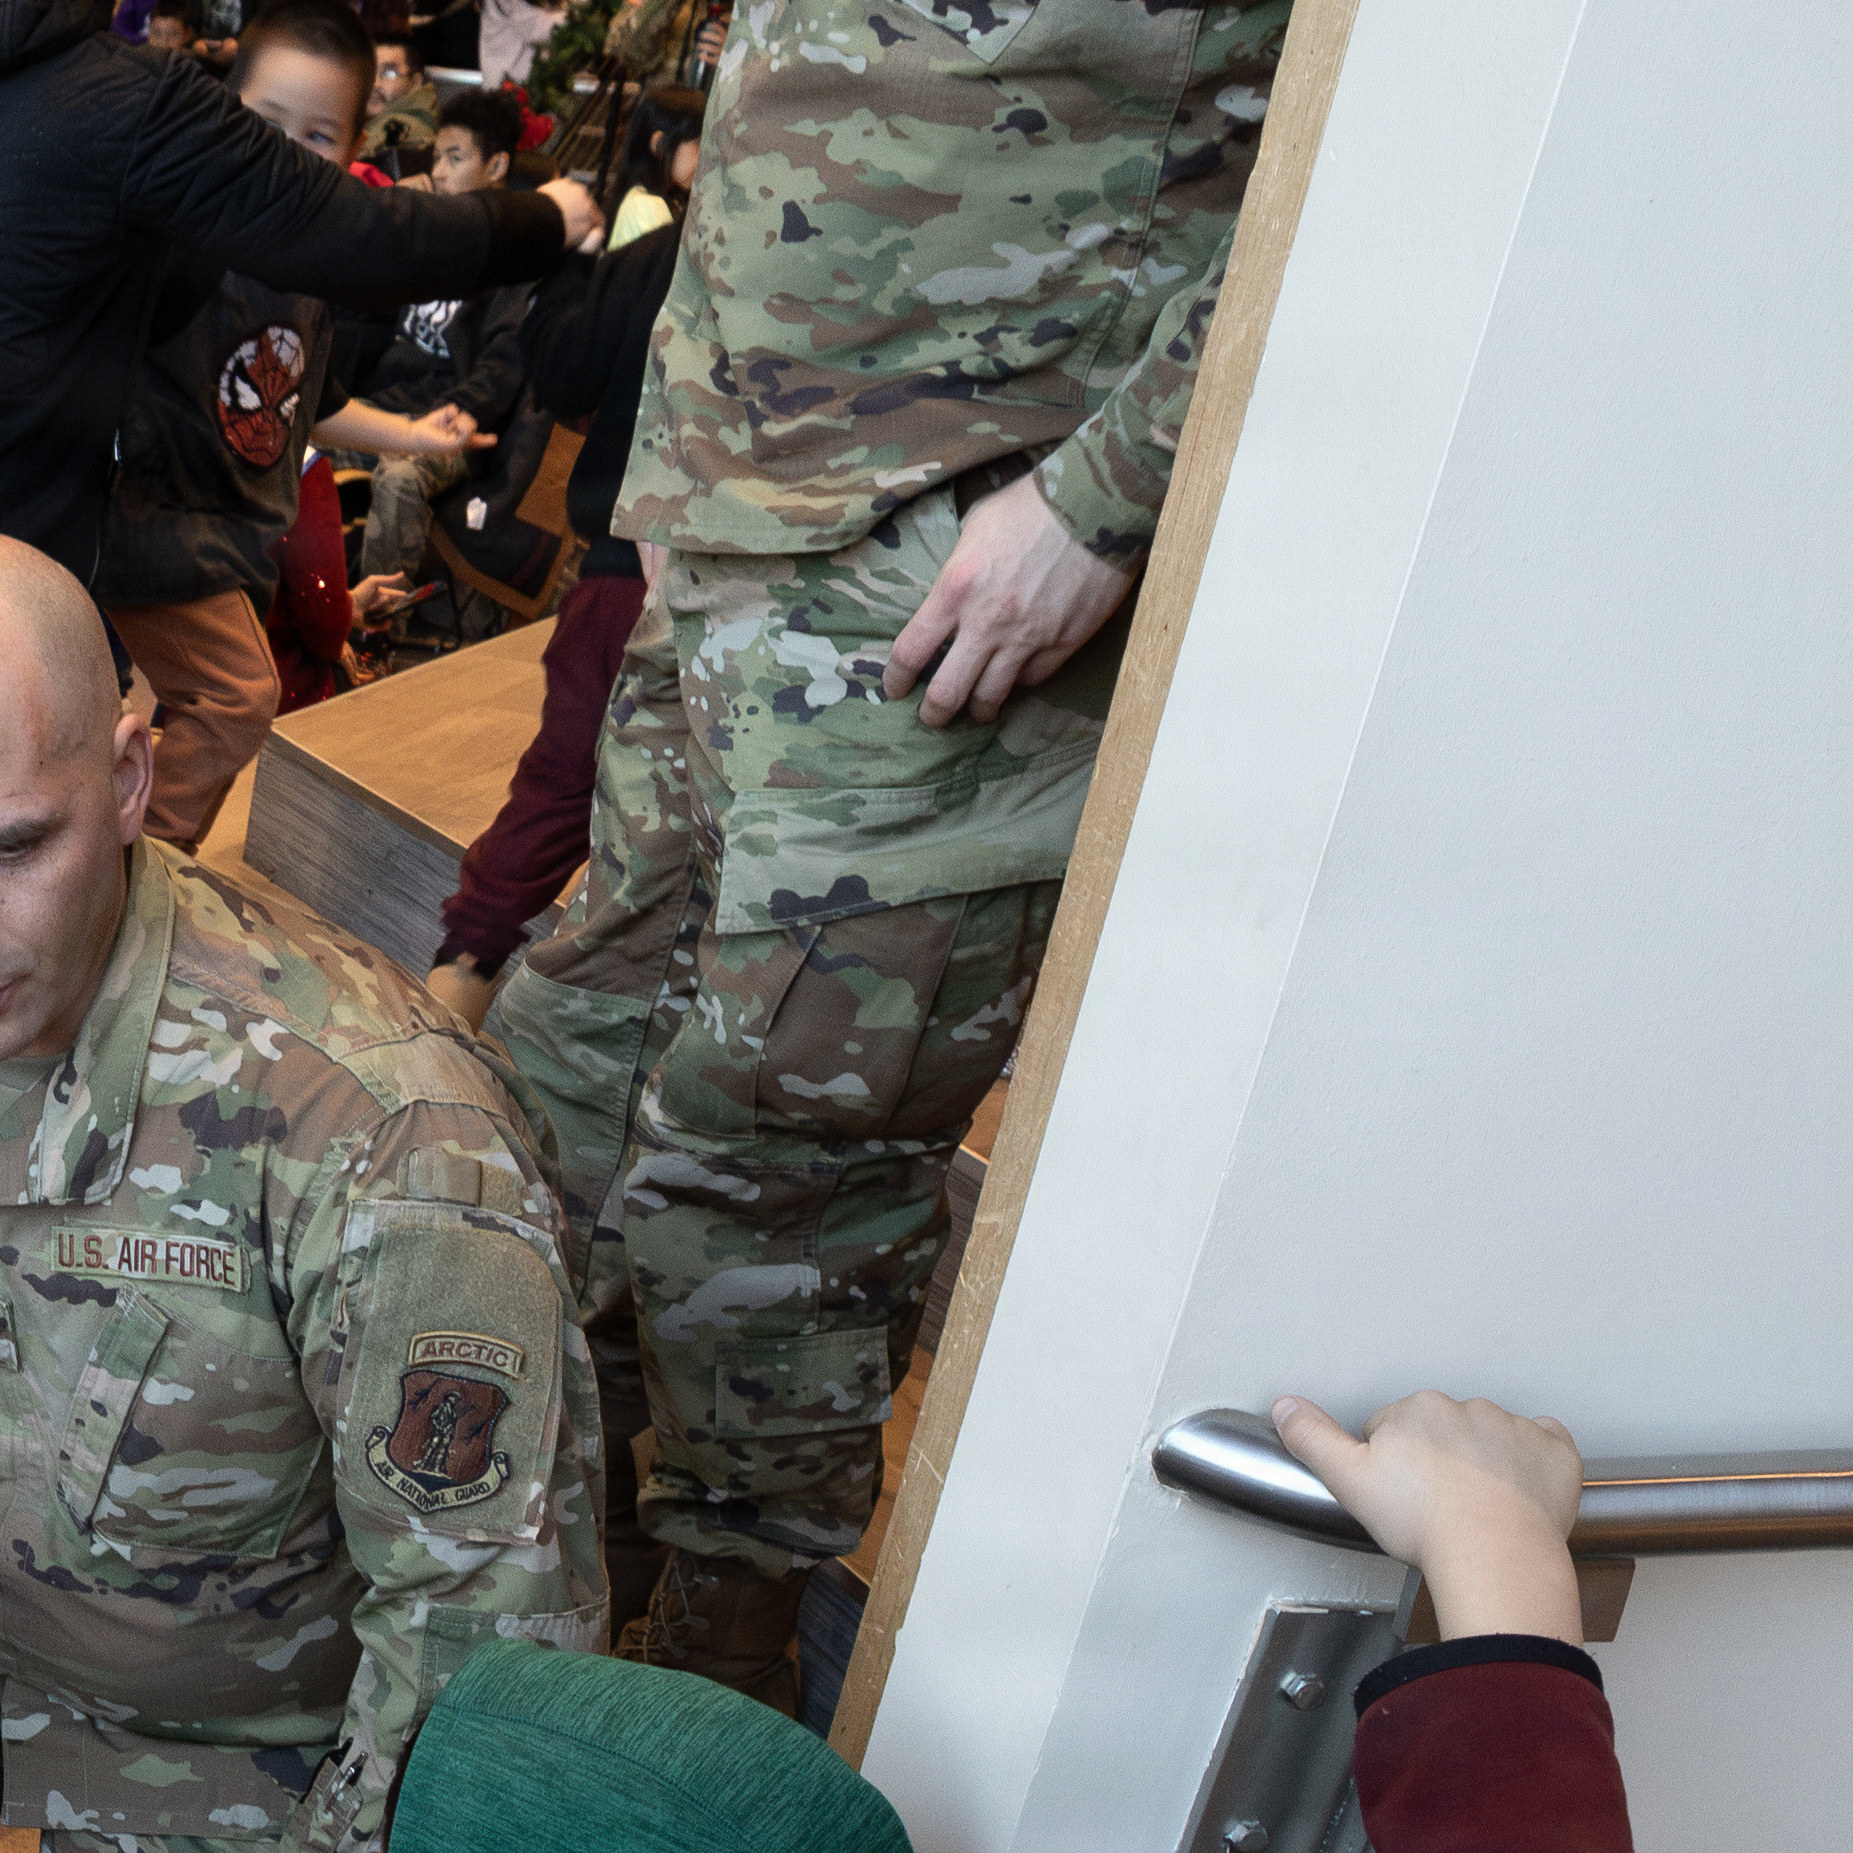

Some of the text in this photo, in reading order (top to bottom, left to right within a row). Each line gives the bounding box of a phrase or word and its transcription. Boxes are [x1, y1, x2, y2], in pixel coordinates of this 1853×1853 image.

[57, 1232, 235, 1286] U.S. AIR FORCE
[420, 1340, 509, 1368] ARCTIC
[374, 1460, 491, 1510] AIR NATIONAL GUARD
